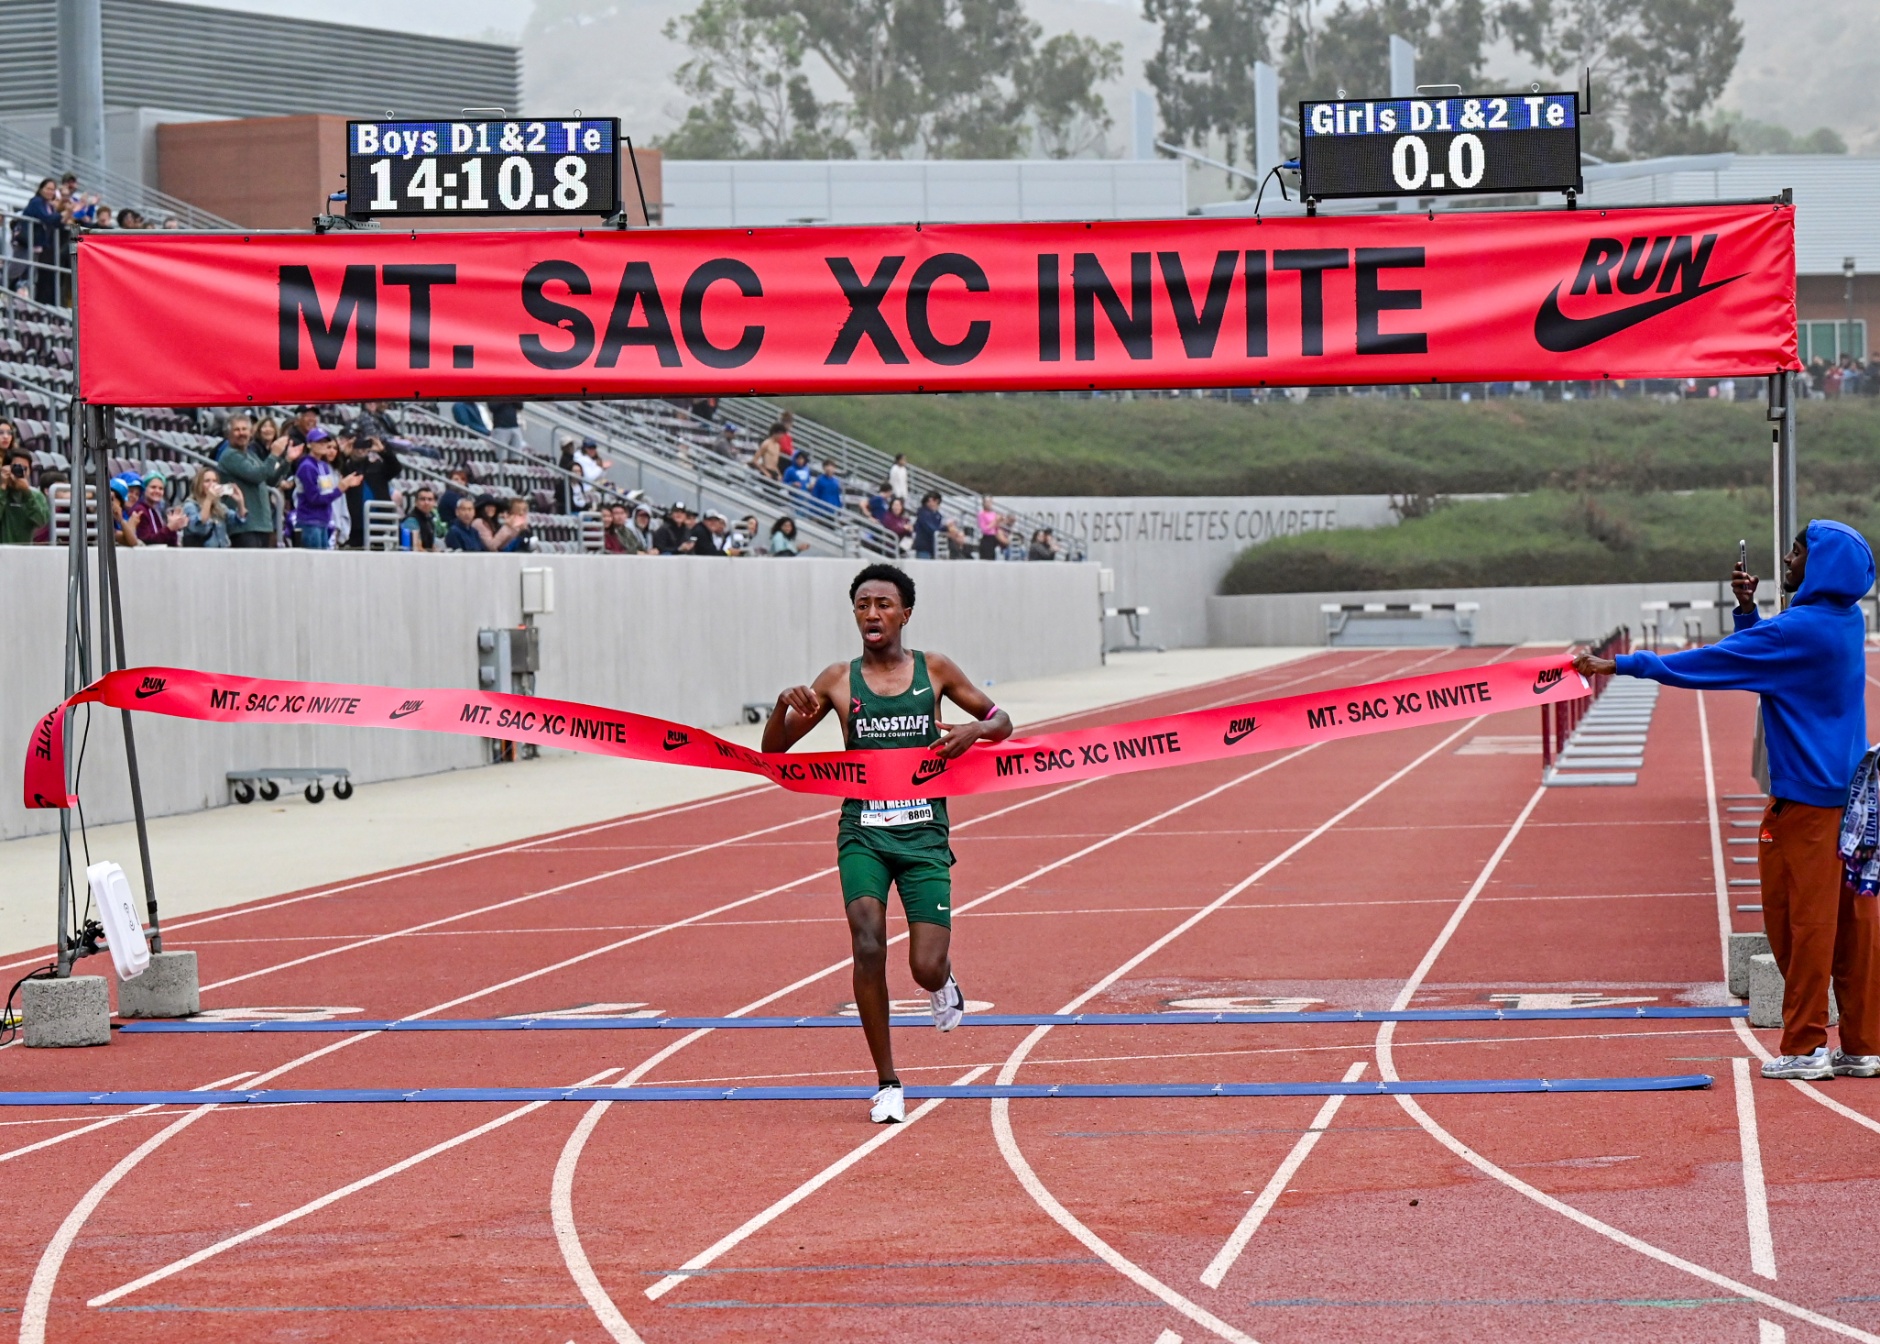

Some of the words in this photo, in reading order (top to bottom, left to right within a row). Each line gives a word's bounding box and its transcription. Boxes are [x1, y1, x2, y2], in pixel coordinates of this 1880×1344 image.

[1311, 103, 1396, 134] Girls
[1525, 97, 1564, 128] Te
[357, 124, 438, 159] Boys
[562, 122, 601, 151] Te
[1392, 133, 1485, 190] 0.0
[370, 155, 588, 210] 14:10.8
[1569, 234, 1717, 296] RUN
[278, 264, 474, 370] MT.
[519, 257, 766, 370] SAC
[824, 252, 991, 365] XC
[1037, 246, 1428, 361] INVITE
[1092, 511, 1134, 542] BEST
[1137, 510, 1229, 541] ATHLETES
[142, 676, 166, 691] RUN
[1537, 667, 1564, 684] RUN
[210, 689, 240, 710] MT.
[245, 693, 279, 712] SAC
[281, 694, 305, 713] XC
[306, 696, 361, 715] INVITE
[399, 700, 424, 712] RUN
[1307, 706, 1342, 729] MT.
[1348, 699, 1389, 723] SAC
[1395, 693, 1422, 715] XC
[1427, 681, 1492, 710] INVITE
[460, 703, 491, 725] MT.
[497, 708, 536, 731] SAC
[539, 714, 566, 735] XC
[570, 717, 627, 744] INVITE
[667, 729, 688, 743] RUN
[856, 715, 929, 738] FLAGSTAFF
[1229, 717, 1256, 734] RUN
[919, 757, 948, 774] RUN
[995, 753, 1028, 777] MT.
[1034, 748, 1076, 773] SAC
[1082, 743, 1107, 766] XC
[1114, 731, 1181, 761] INVITE
[776, 763, 806, 780] XC
[809, 762, 867, 784] INVITE
[908, 809, 931, 820] 8809
